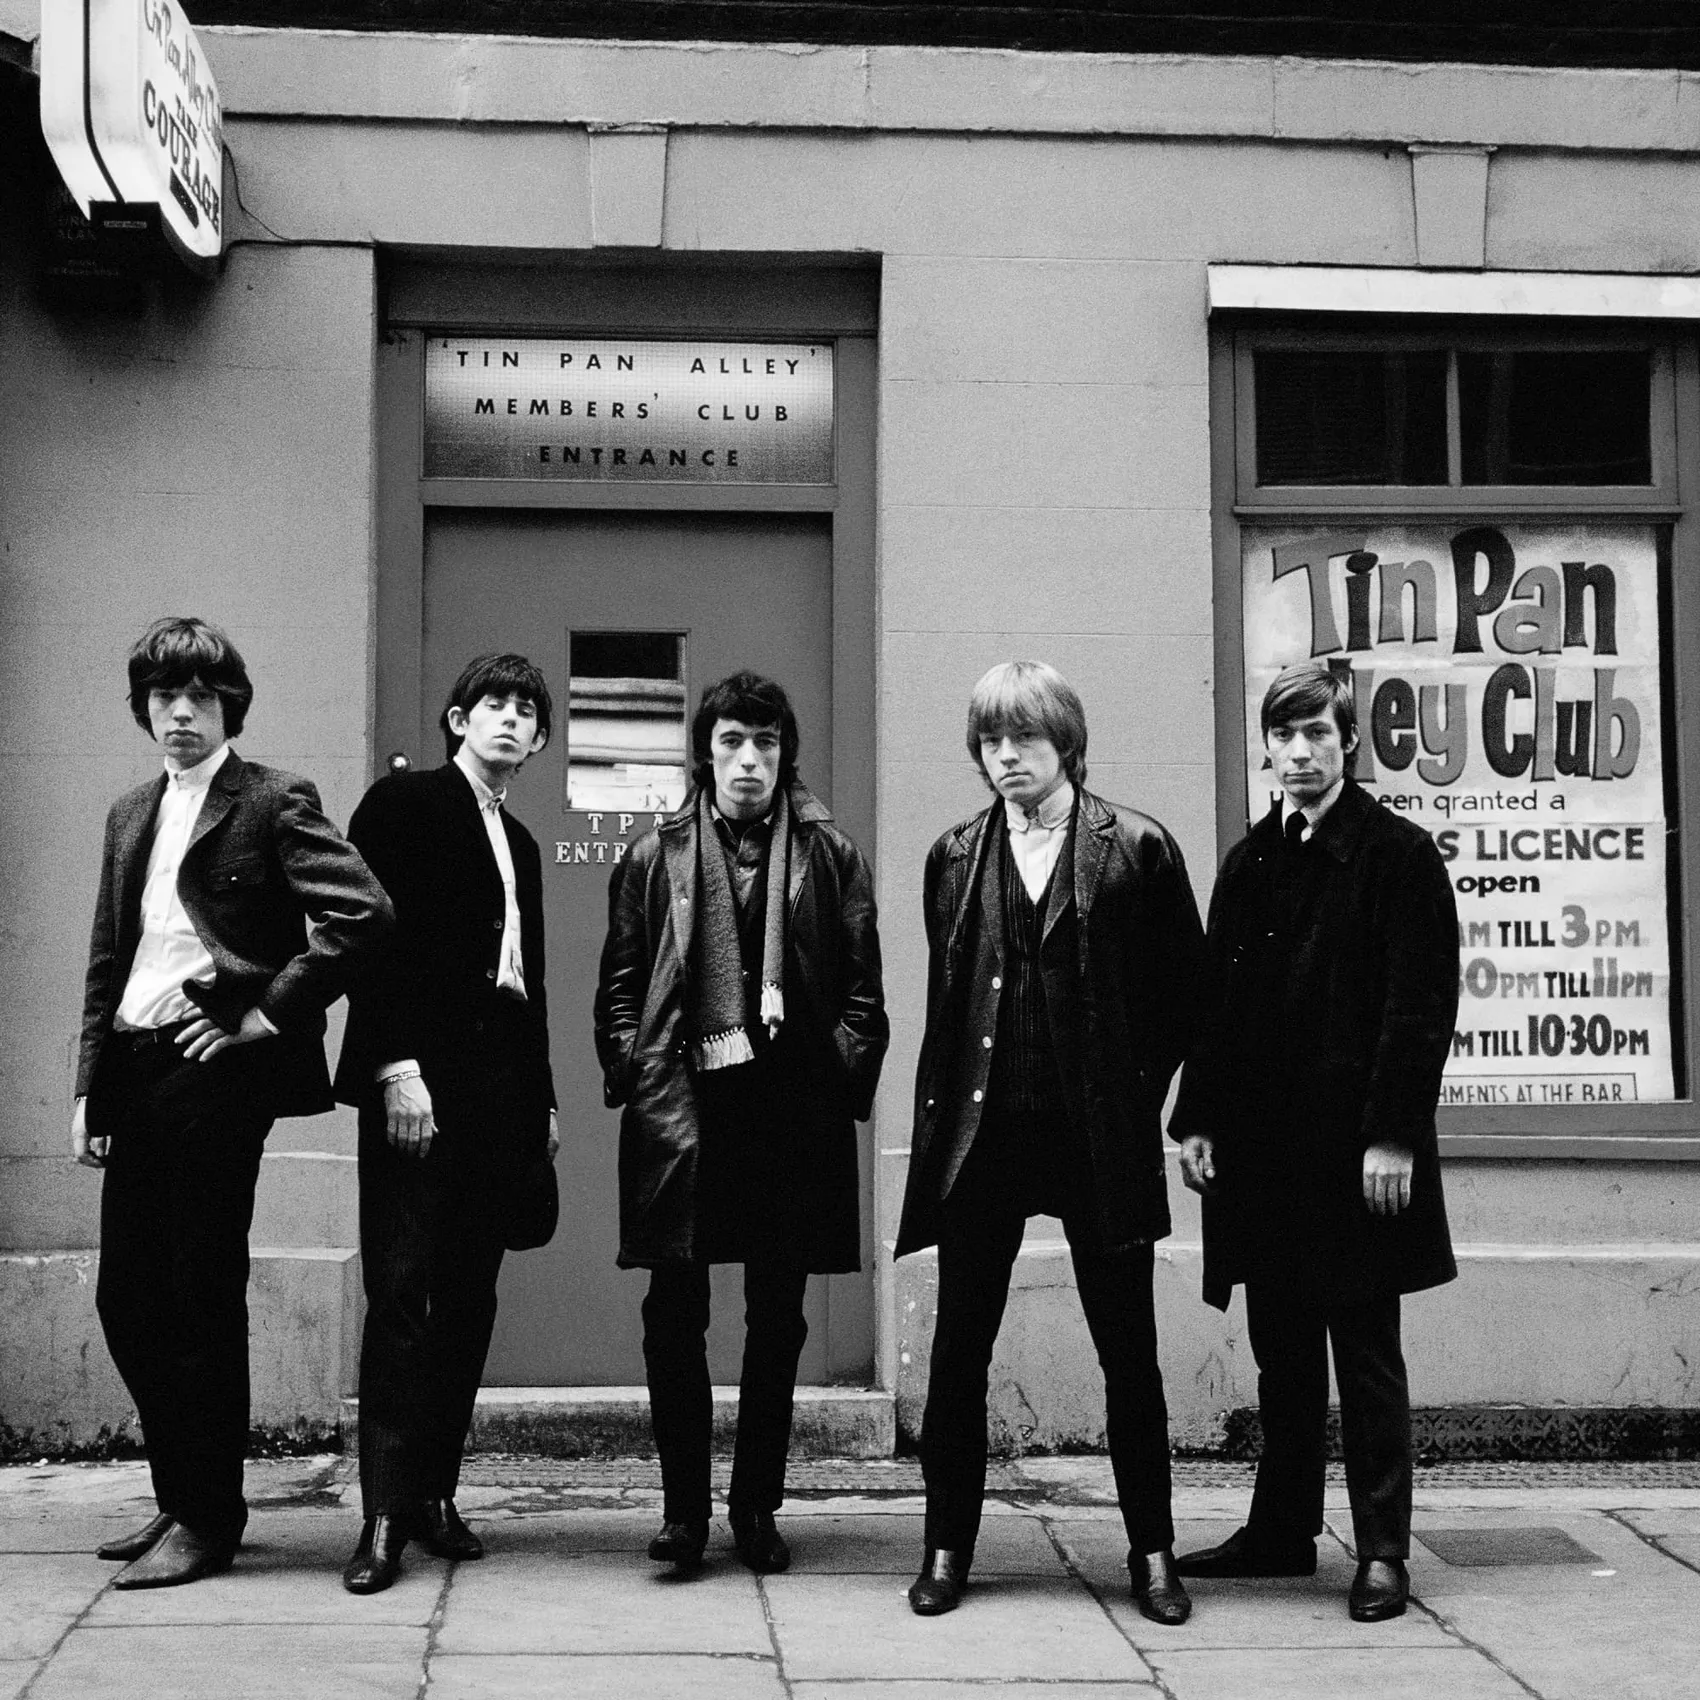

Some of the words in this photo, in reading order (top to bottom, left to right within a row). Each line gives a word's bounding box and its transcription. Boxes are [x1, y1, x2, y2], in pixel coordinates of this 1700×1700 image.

[143, 79, 219, 236] COURAGE
[560, 353, 634, 370] PAN
[698, 404, 788, 421] CLUB
[540, 446, 739, 466] ENTRANCE
[1272, 536, 1438, 657] Tin
[1450, 526, 1618, 655] Pan
[1481, 662, 1641, 781] Club
[1378, 794, 1423, 810] een
[1549, 795, 1565, 810] a
[1475, 828, 1645, 862] LICENCE
[1456, 875, 1541, 897] open
[1498, 921, 1556, 947] TILL
[1544, 972, 1591, 998] TILL
[1479, 1030, 1524, 1057] TILL
[1439, 1085, 1510, 1104] HMENTS
[1517, 1084, 1533, 1102] AT
[1581, 1082, 1622, 1101] BAR
